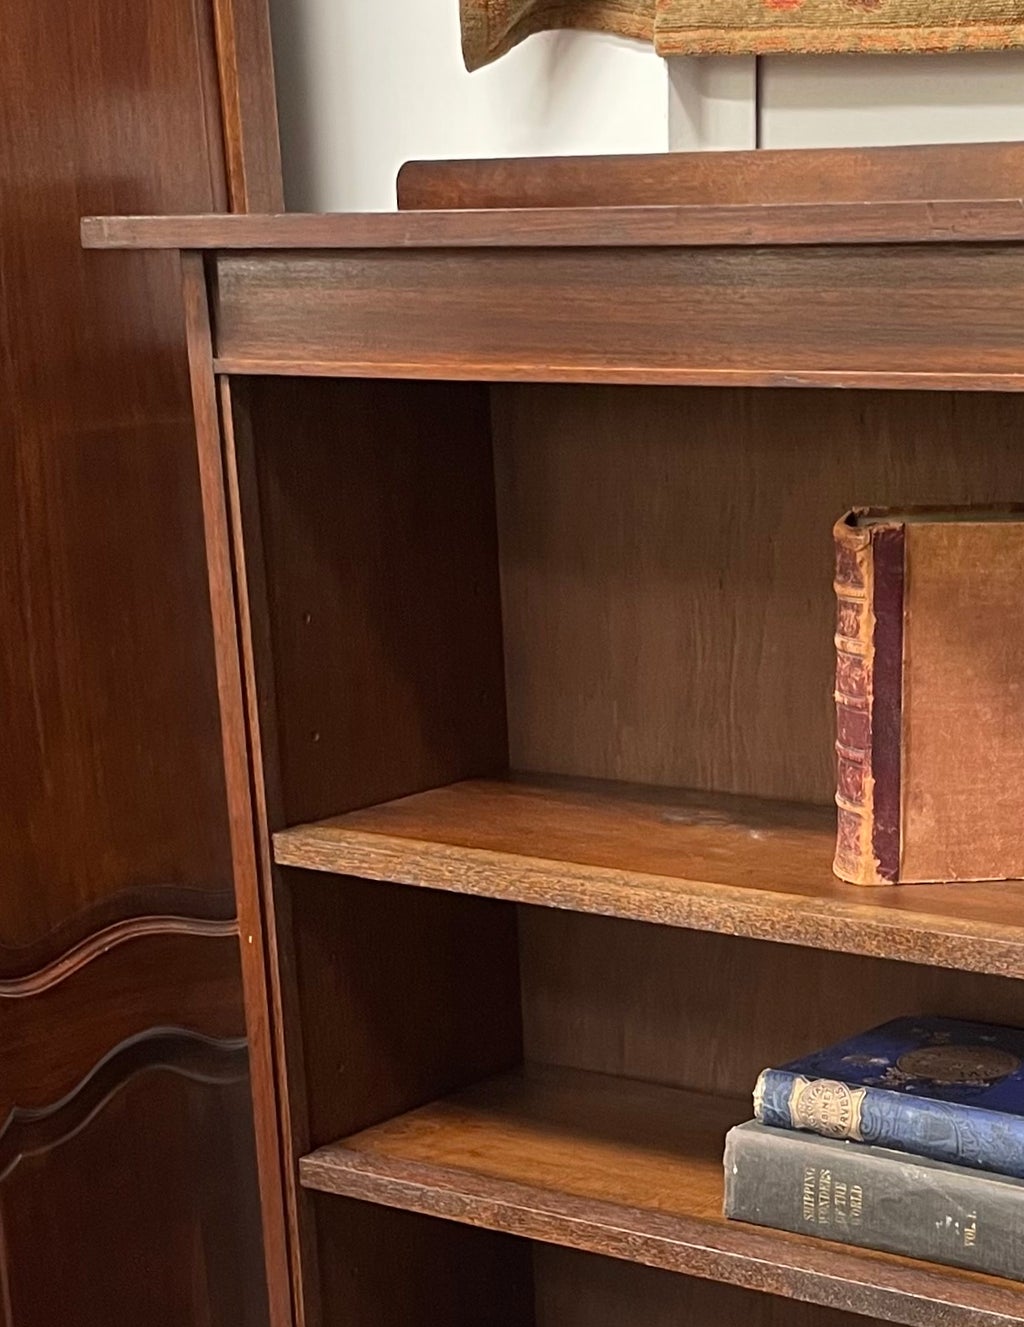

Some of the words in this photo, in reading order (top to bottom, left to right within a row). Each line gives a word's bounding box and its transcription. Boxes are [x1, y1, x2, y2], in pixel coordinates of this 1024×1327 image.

[820, 1087, 831, 1130] ABINET
[803, 1167, 815, 1222] SHIPPING
[834, 1182, 847, 1207] THE
